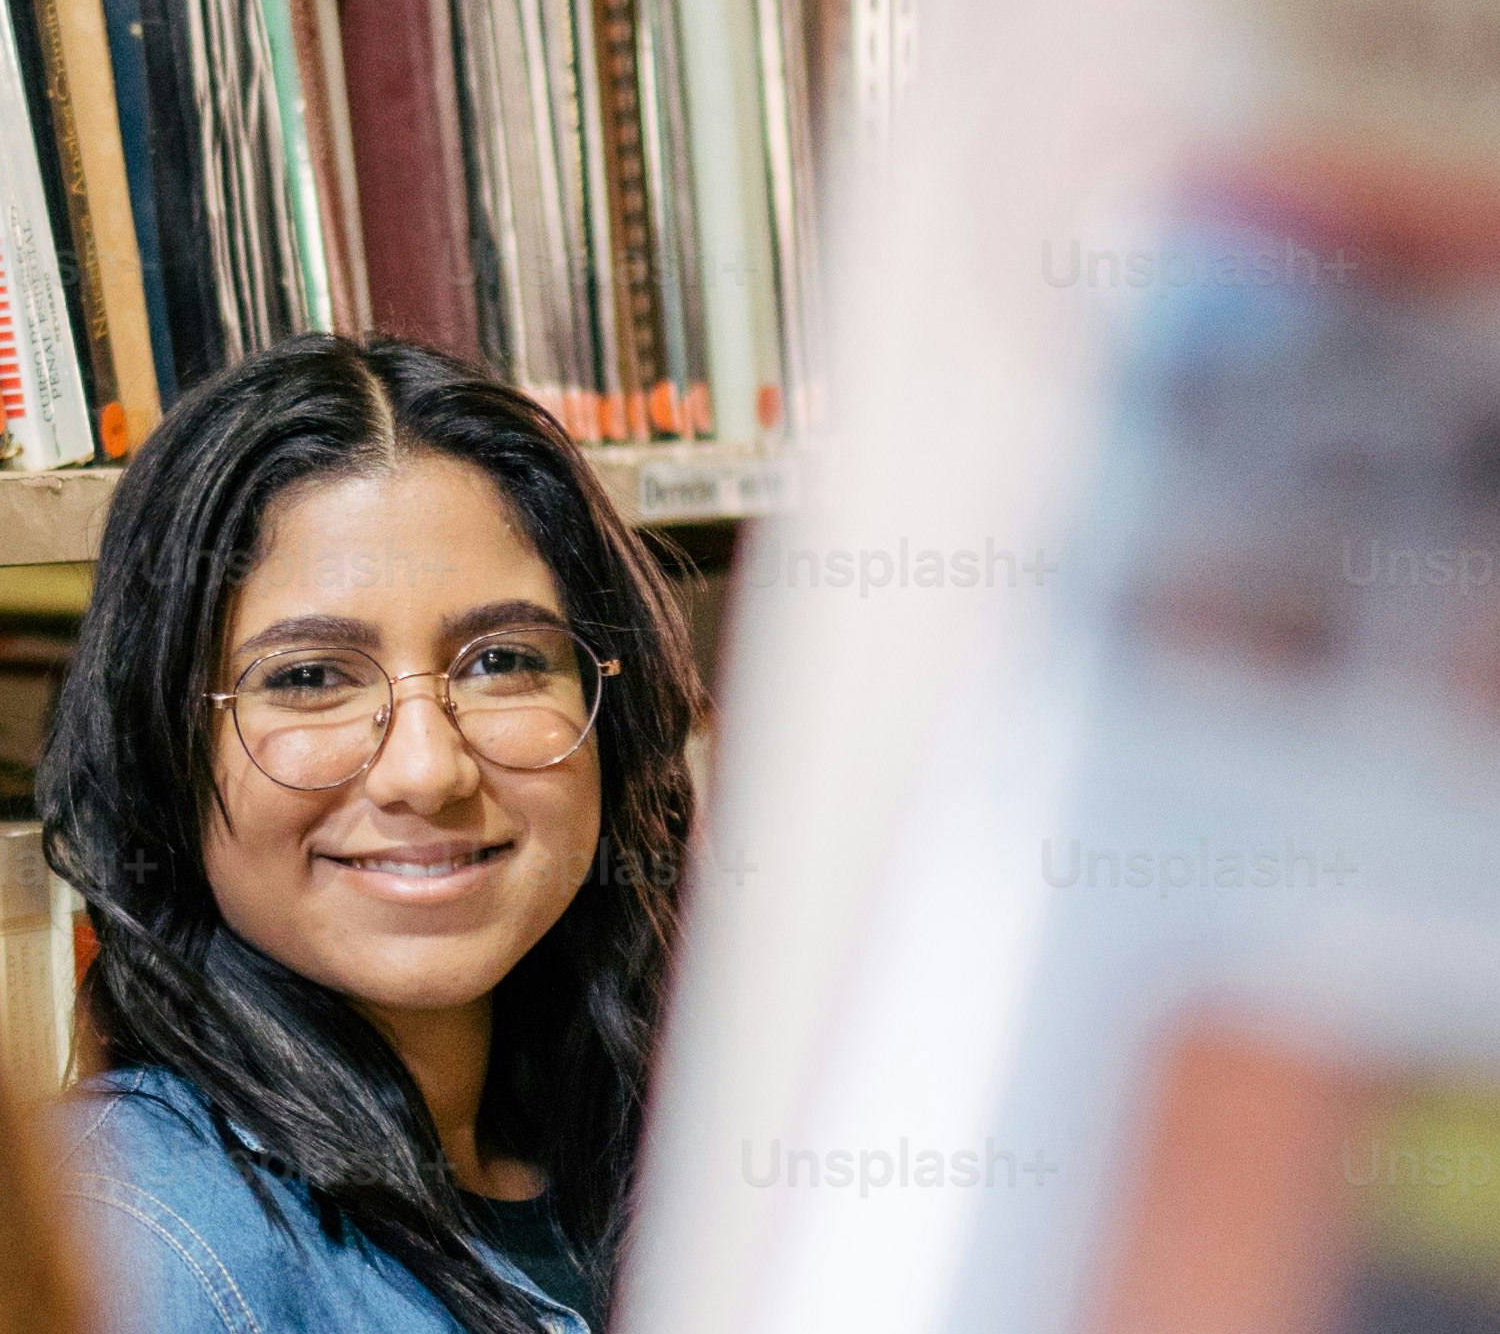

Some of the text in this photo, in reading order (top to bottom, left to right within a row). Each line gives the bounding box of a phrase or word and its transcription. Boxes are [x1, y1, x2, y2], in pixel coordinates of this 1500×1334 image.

[19, 217, 63, 400] PENAL ESPECIAL
[25, 317, 41, 344] DE
[42, 270, 62, 342] REVISADO
[31, 349, 55, 422] CURSO
